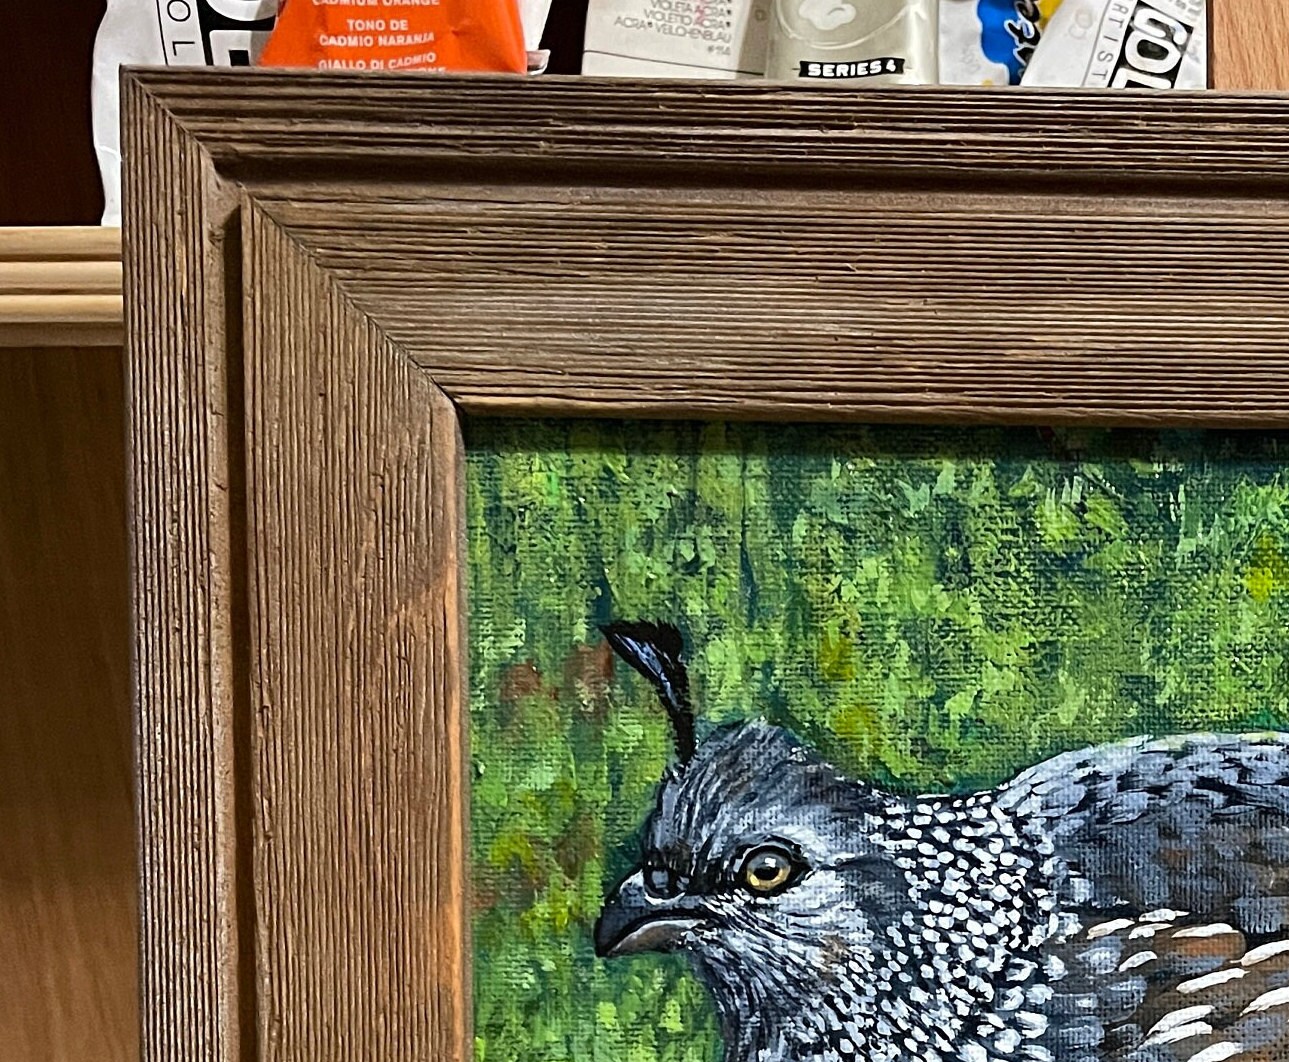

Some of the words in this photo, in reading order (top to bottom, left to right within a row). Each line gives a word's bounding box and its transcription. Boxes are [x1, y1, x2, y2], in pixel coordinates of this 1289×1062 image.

[346, 19, 386, 31] TONO
[389, 19, 409, 31] DE
[319, 34, 374, 47] CADMIO
[377, 32, 435, 46] NARANJA
[807, 60, 882, 77] SERIES
[886, 59, 897, 73] 4
